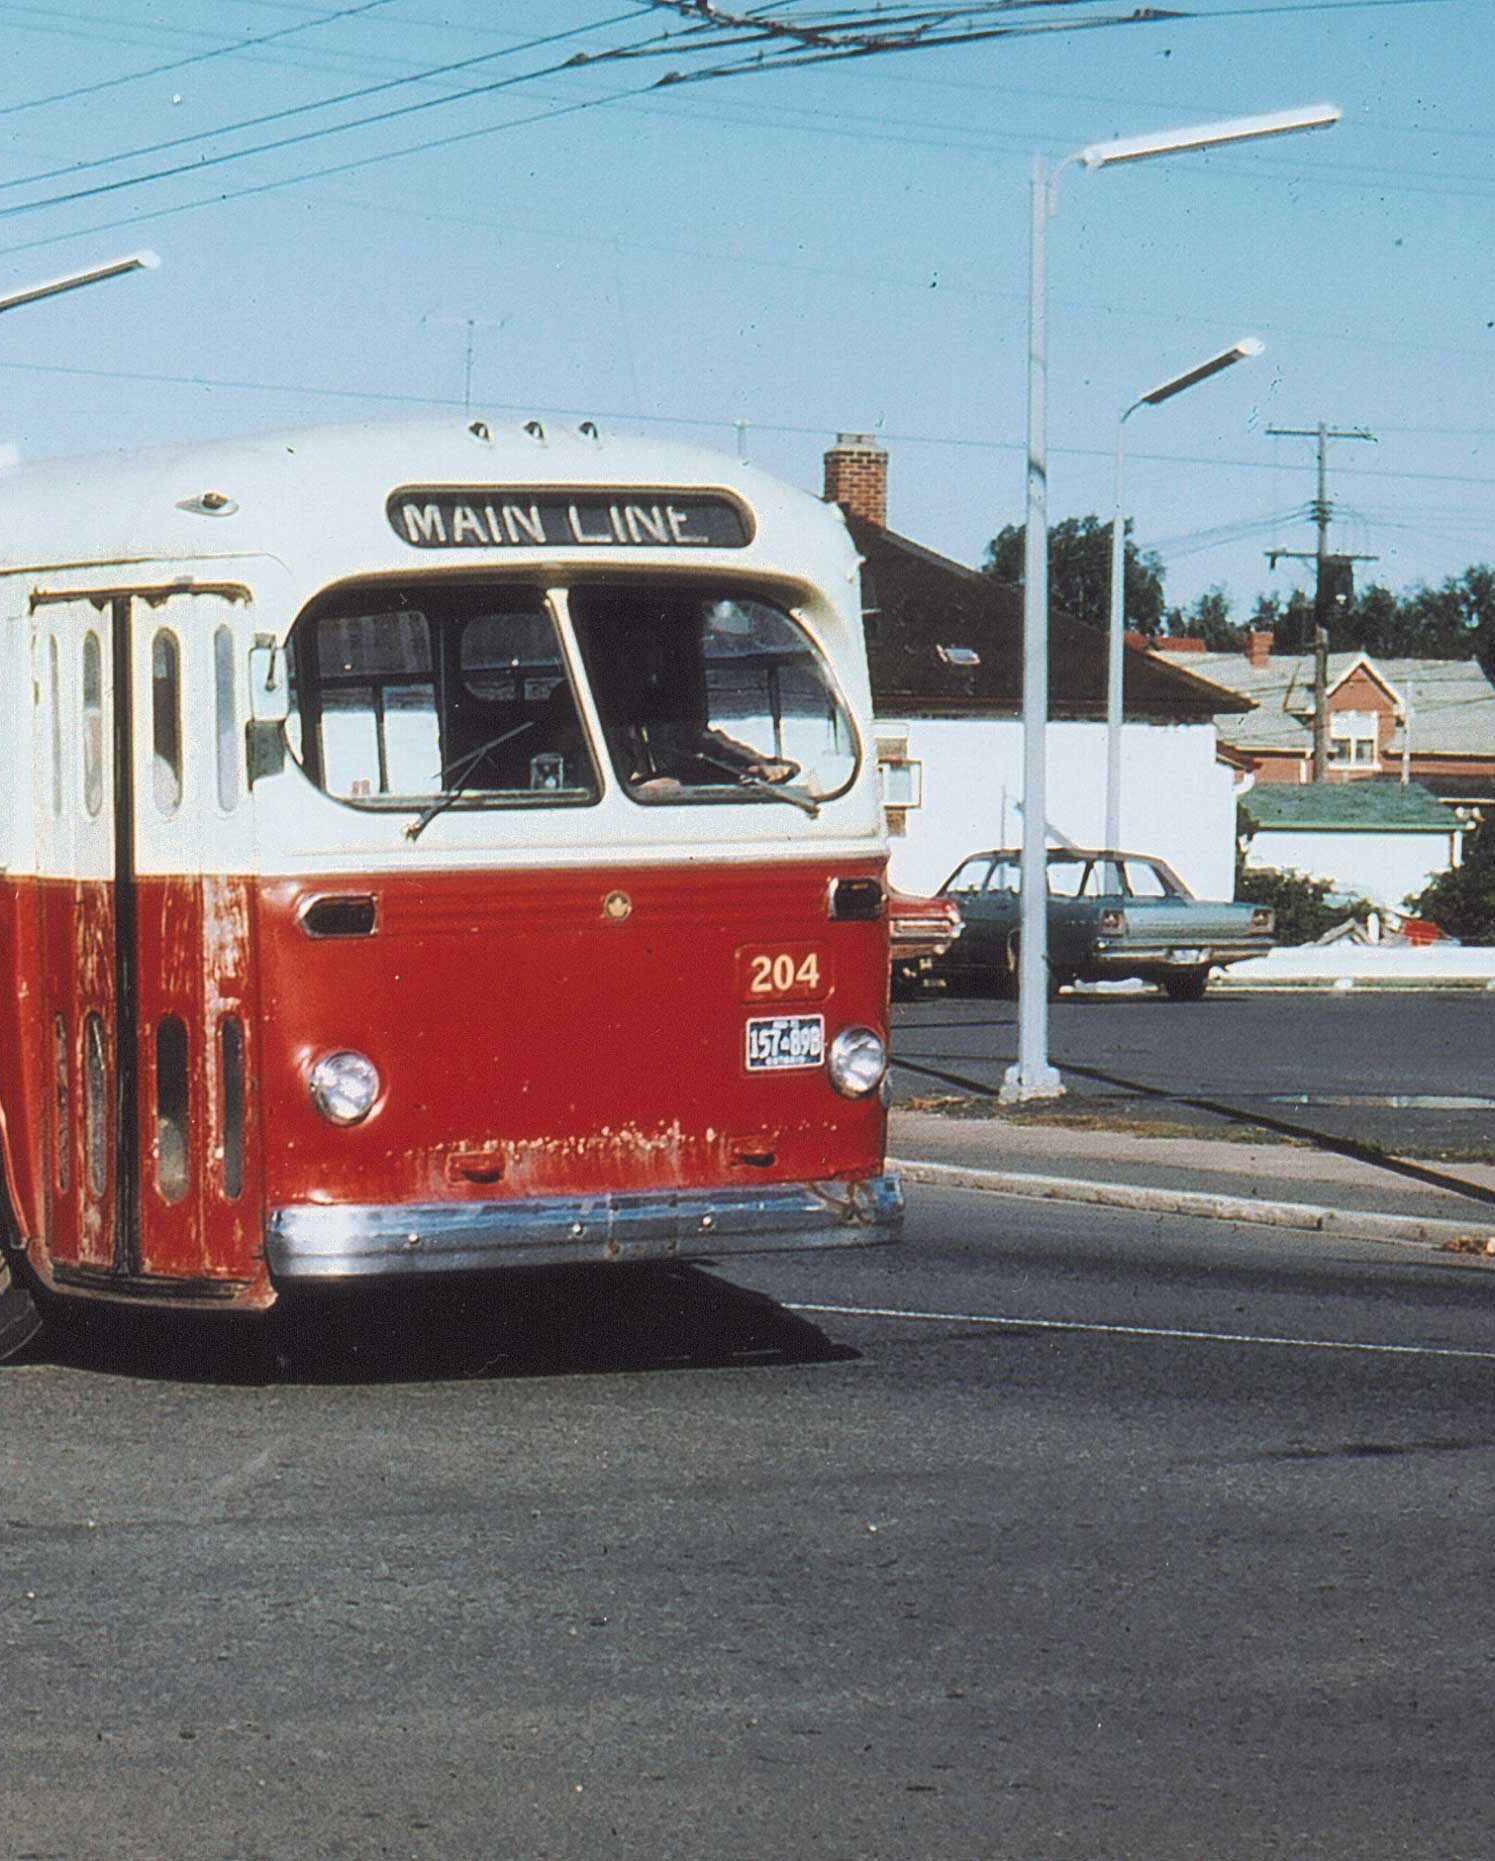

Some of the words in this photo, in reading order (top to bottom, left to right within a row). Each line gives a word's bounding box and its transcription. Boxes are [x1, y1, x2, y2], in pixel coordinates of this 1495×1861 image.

[403, 504, 546, 543] MAIN
[568, 505, 709, 543] LINE
[750, 952, 820, 993] 204
